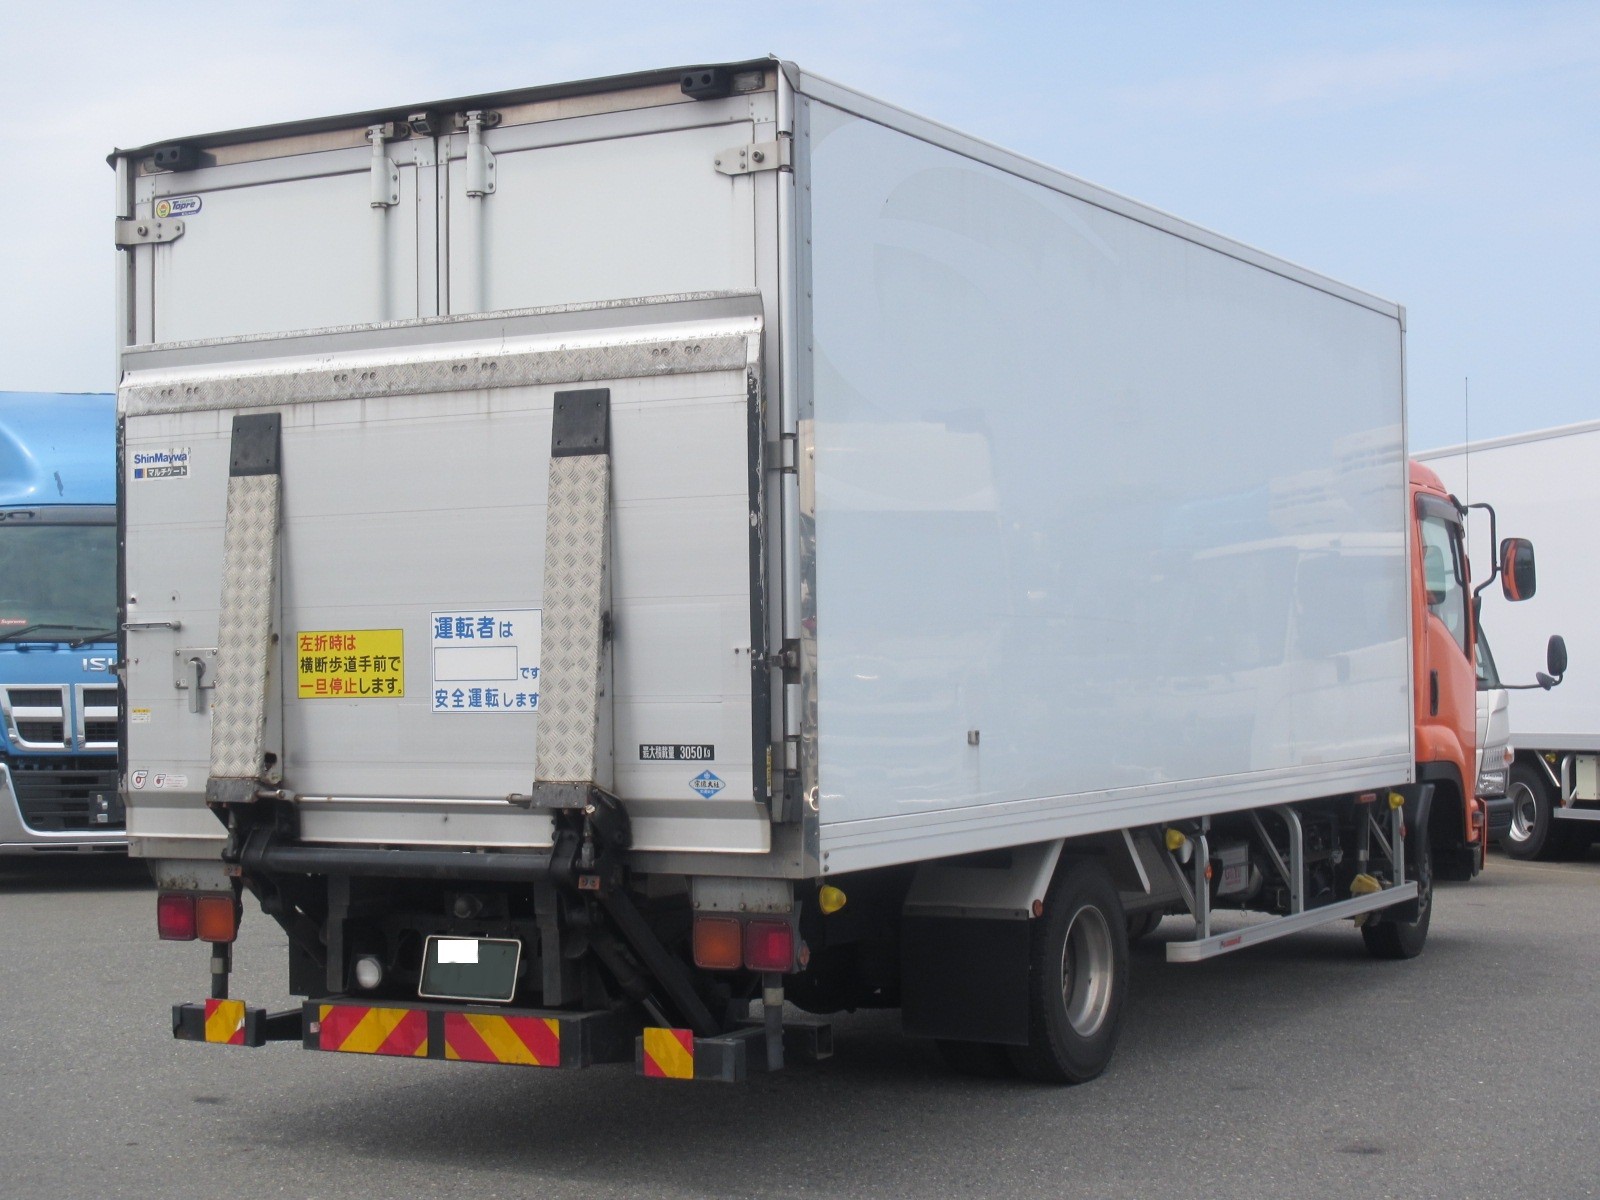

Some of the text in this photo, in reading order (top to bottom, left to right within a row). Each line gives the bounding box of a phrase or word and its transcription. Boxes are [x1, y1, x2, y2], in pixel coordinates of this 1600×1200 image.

[172, 200, 196, 211] Topre
[134, 453, 188, 464] ShinMaywa
[434, 615, 513, 639] 運転者は
[300, 634, 356, 652] 左折時は
[300, 655, 401, 674] 横断歩道手前で
[519, 666, 540, 679] です
[300, 676, 402, 694] 一旦停止します。
[434, 687, 540, 708] 安全運転します
[642, 745, 675, 759] 最大積載量
